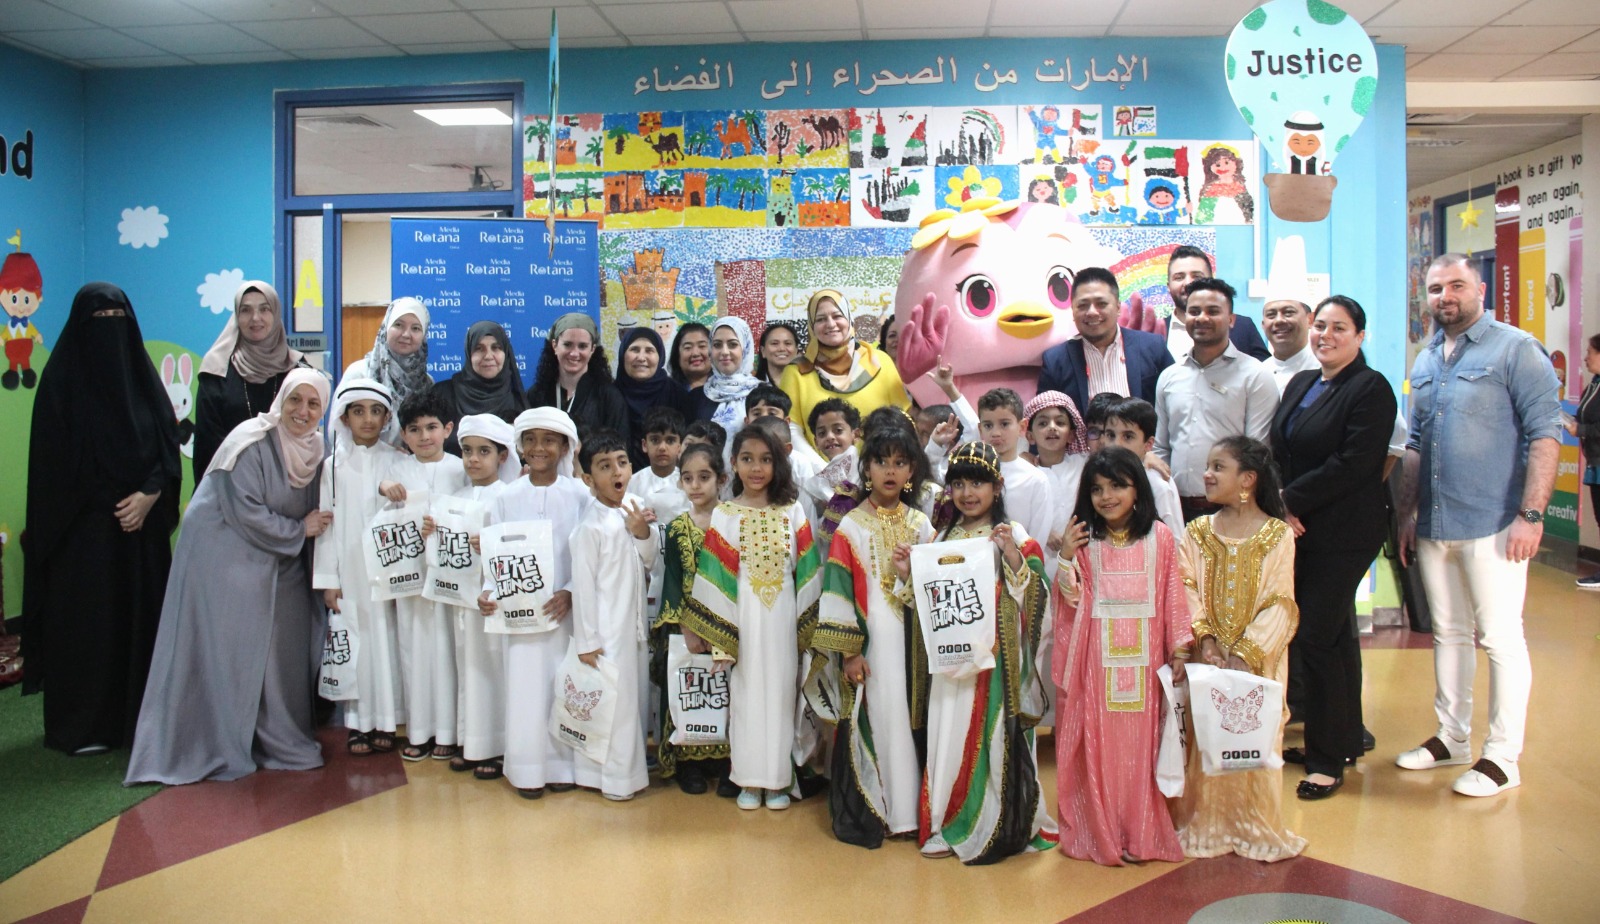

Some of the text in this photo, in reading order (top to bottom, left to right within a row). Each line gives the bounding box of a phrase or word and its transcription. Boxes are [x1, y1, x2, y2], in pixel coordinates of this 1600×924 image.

[1247, 47, 1362, 76] Justice
[633, 54, 1148, 99] الإمارات من الصحراء إلى الفضاء
[1496, 174, 1502, 186] A
[1503, 166, 1522, 185] book
[1527, 164, 1535, 178] is
[1538, 163, 1544, 174] a
[1548, 155, 1564, 176] gift
[1527, 191, 1548, 208] open
[1527, 213, 1543, 229] and
[414, 230, 460, 243] Rotana
[480, 231, 524, 243] Rotana
[400, 262, 446, 275] Rotana
[466, 262, 511, 275] Rotana
[530, 263, 574, 276] Rotana
[294, 259, 323, 308] A
[480, 294, 525, 307] Rotana
[544, 294, 587, 307] Rotana
[1502, 264, 1511, 324] portant
[1526, 280, 1535, 321] loved
[299, 338, 321, 347] Room
[426, 361, 462, 372] otana
[1547, 505, 1578, 521] creativ
